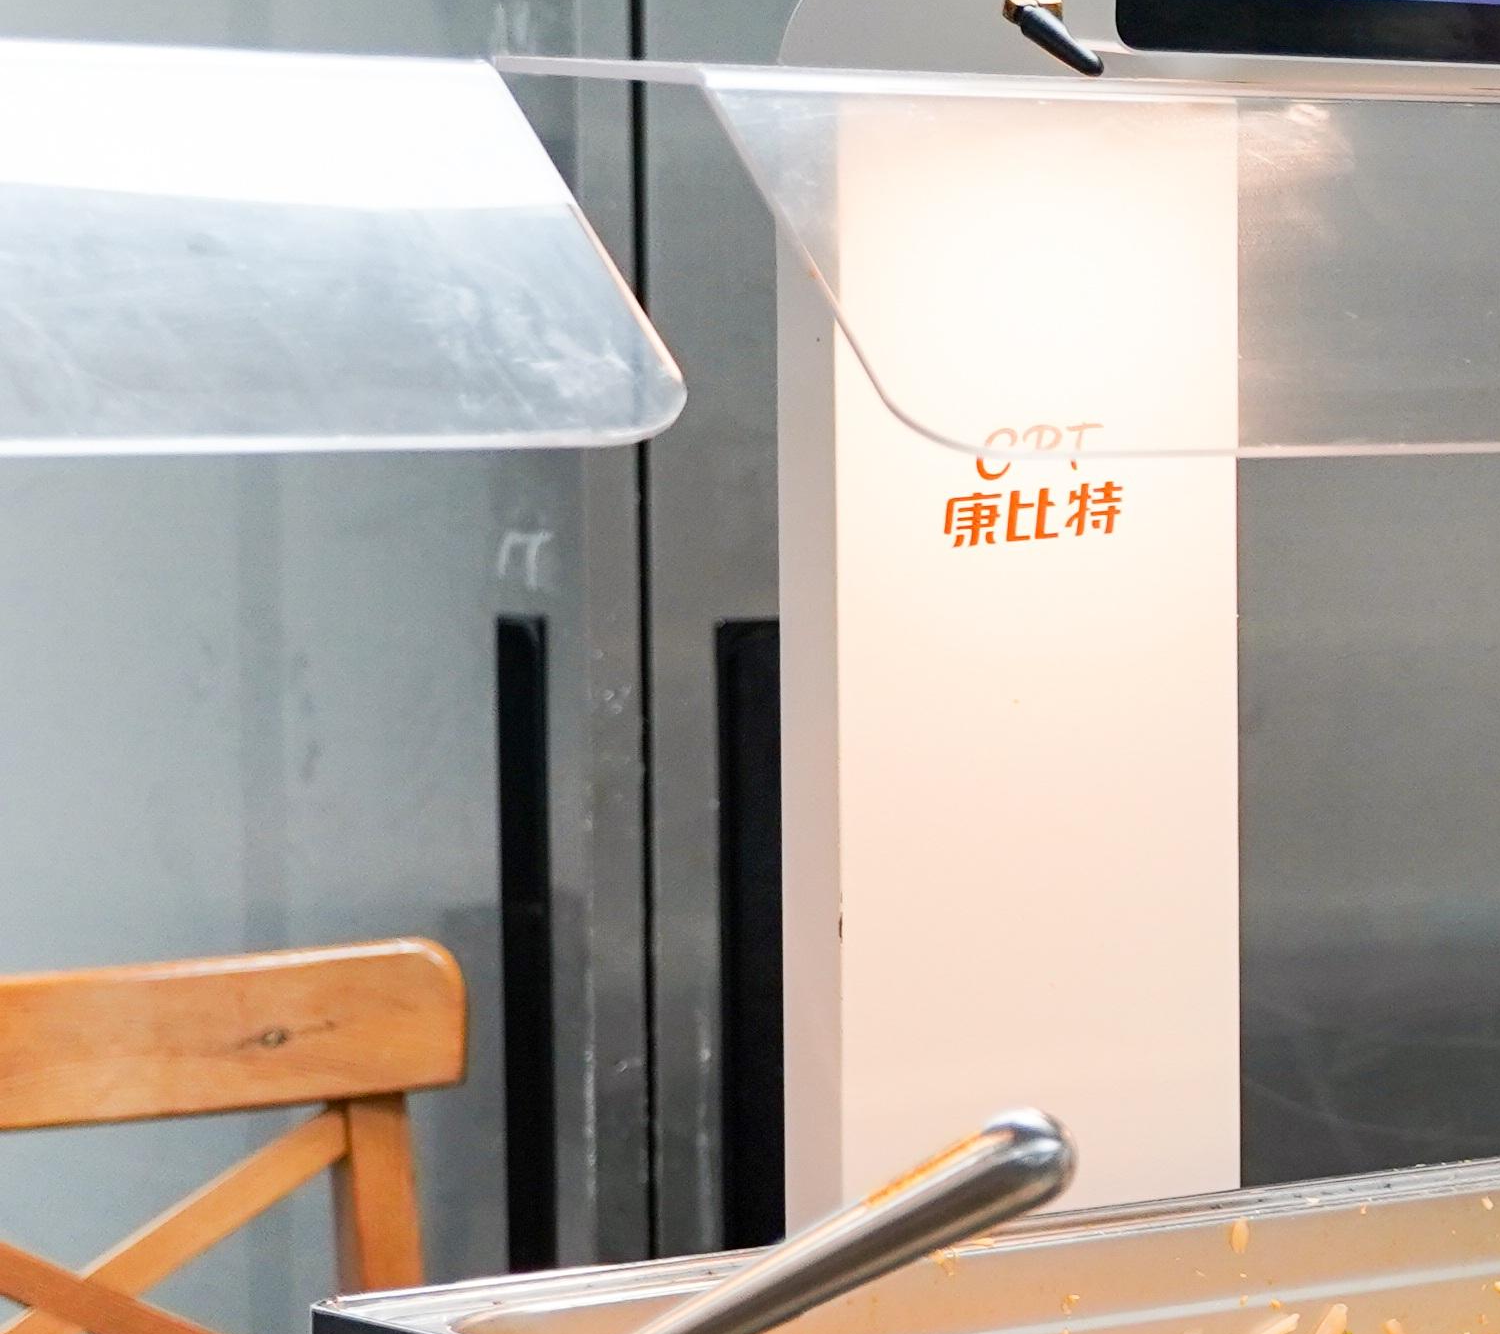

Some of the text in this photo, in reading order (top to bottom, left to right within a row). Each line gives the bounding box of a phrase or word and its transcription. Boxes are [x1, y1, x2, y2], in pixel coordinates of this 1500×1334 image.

[976, 422, 1104, 480] CPT
[944, 480, 1124, 548] 康比特
